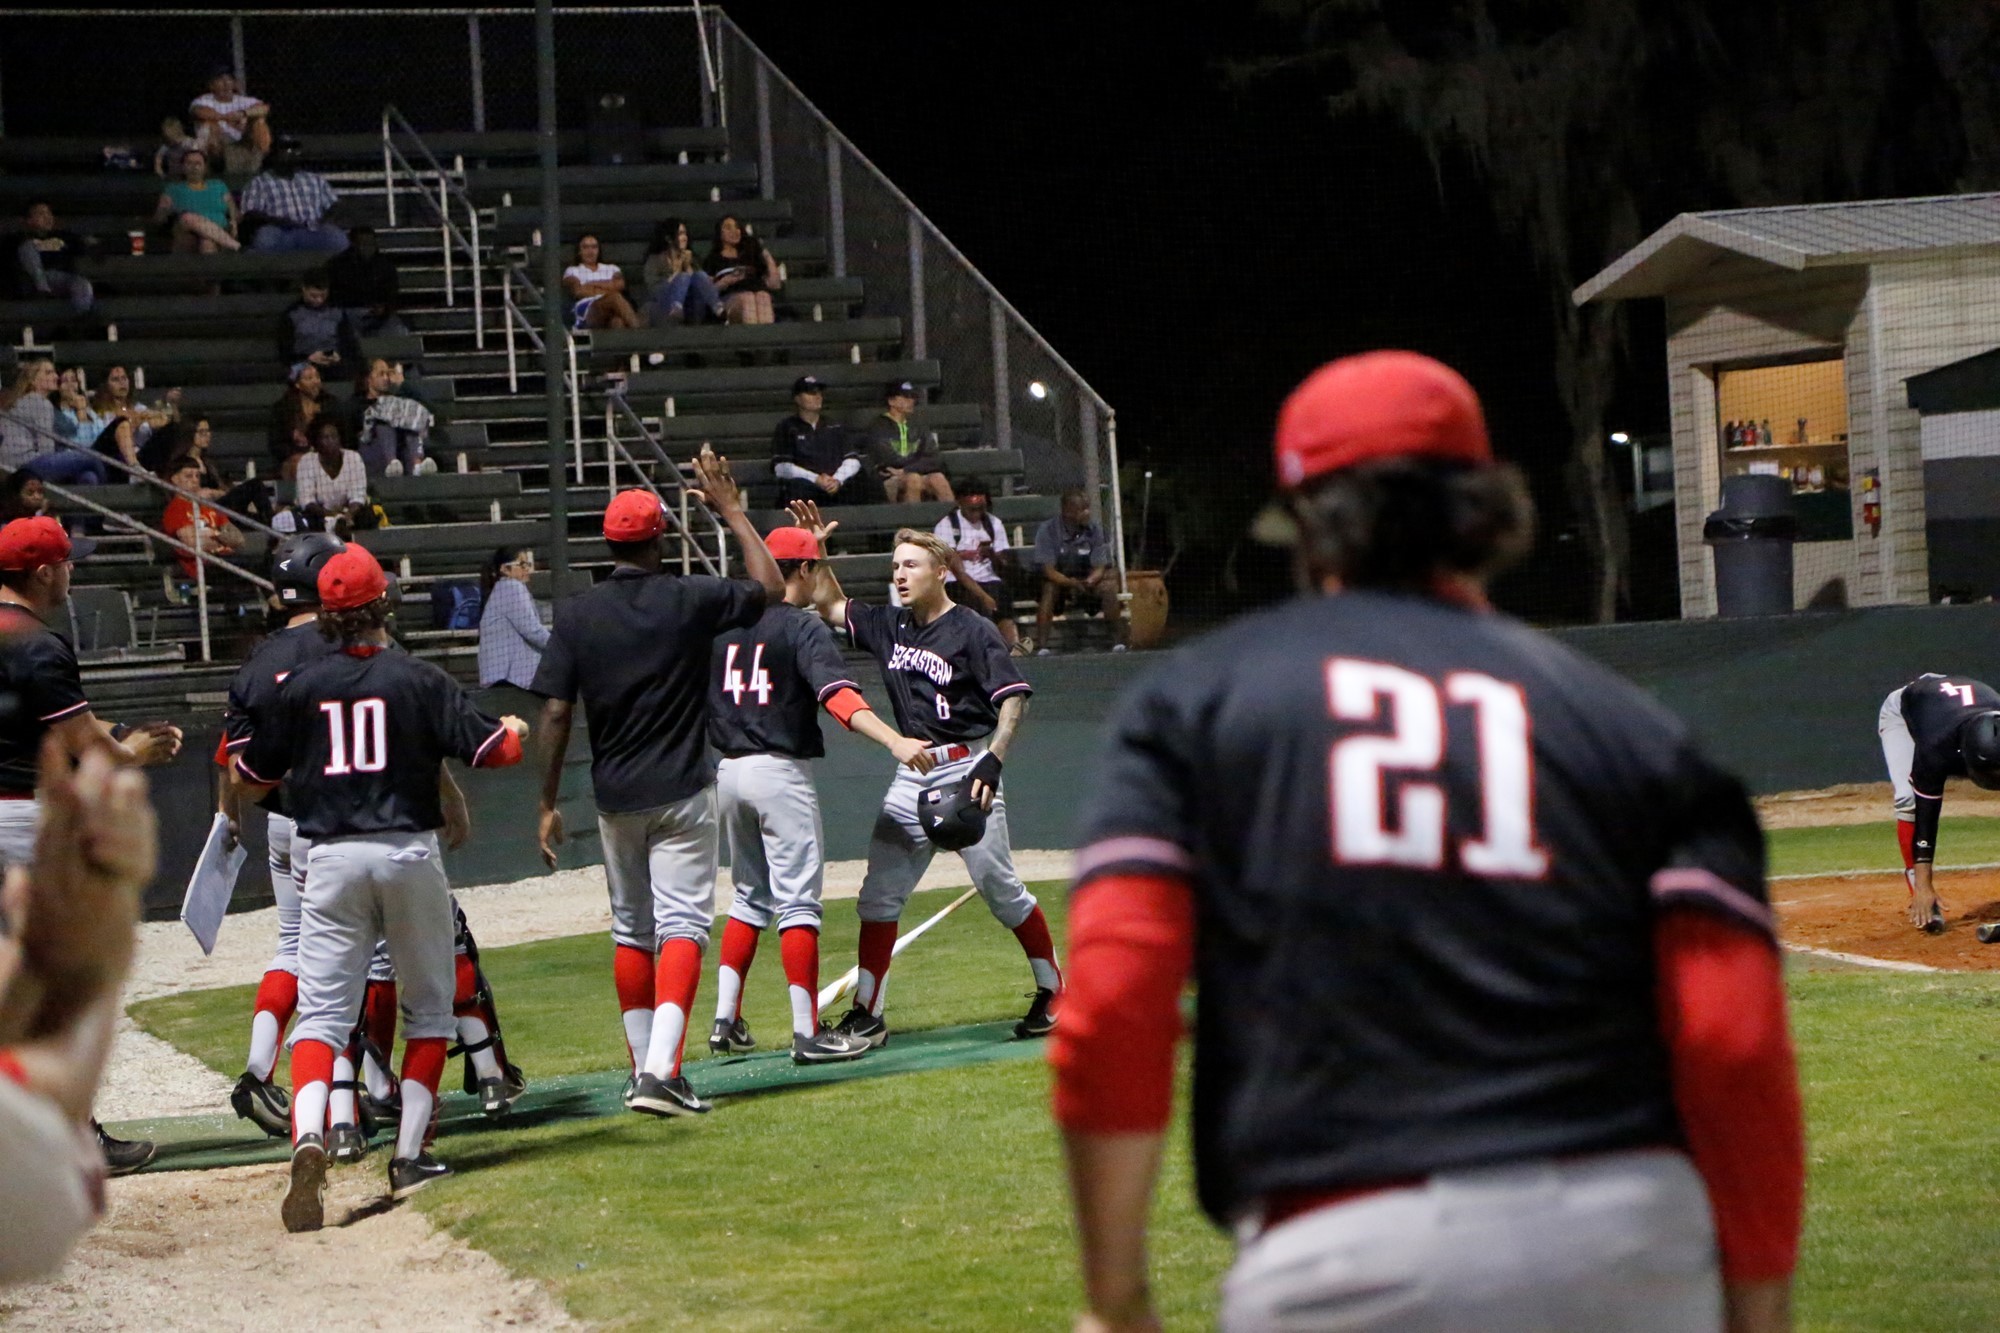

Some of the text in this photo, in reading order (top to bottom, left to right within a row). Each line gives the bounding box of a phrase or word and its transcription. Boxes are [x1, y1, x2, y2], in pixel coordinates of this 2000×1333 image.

[722, 643, 774, 706] 44
[936, 693, 951, 720] 8
[319, 697, 387, 776] 10
[1322, 656, 1552, 880] 21
